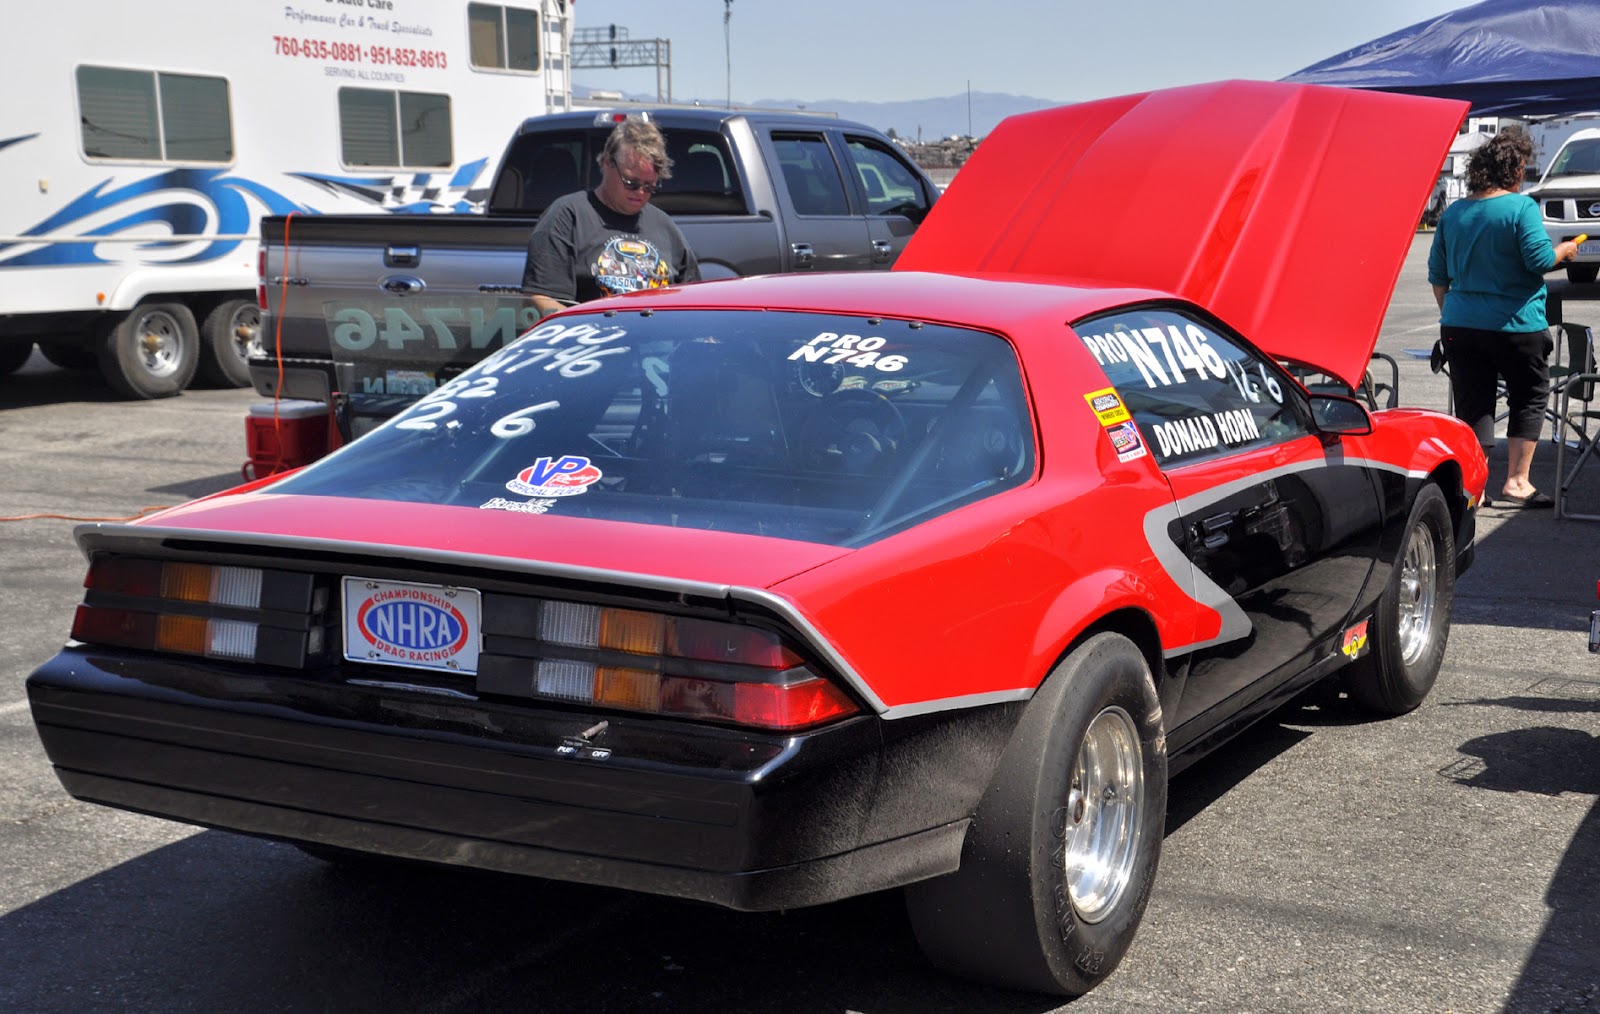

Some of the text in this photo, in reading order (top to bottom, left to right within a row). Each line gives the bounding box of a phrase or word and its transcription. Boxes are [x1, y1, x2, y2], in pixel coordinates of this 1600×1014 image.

[367, 0, 394, 10] Care
[273, 35, 448, 69] 760-635-0881 951-852-8613
[324, 66, 405, 83] SERVING ALL COUNTIES
[807, 332, 887, 351] PRO
[787, 345, 909, 372] N746
[1082, 324, 1227, 388] PRO N746
[1152, 408, 1260, 458] DONALD HORN
[528, 456, 588, 487] VP
[508, 480, 547, 496] OFFICIAL
[373, 589, 452, 611] CHAMPIONSHIP
[376, 603, 453, 648] NHRA
[376, 641, 449, 662] DRAG RACING
[591, 750, 610, 758] OFF
